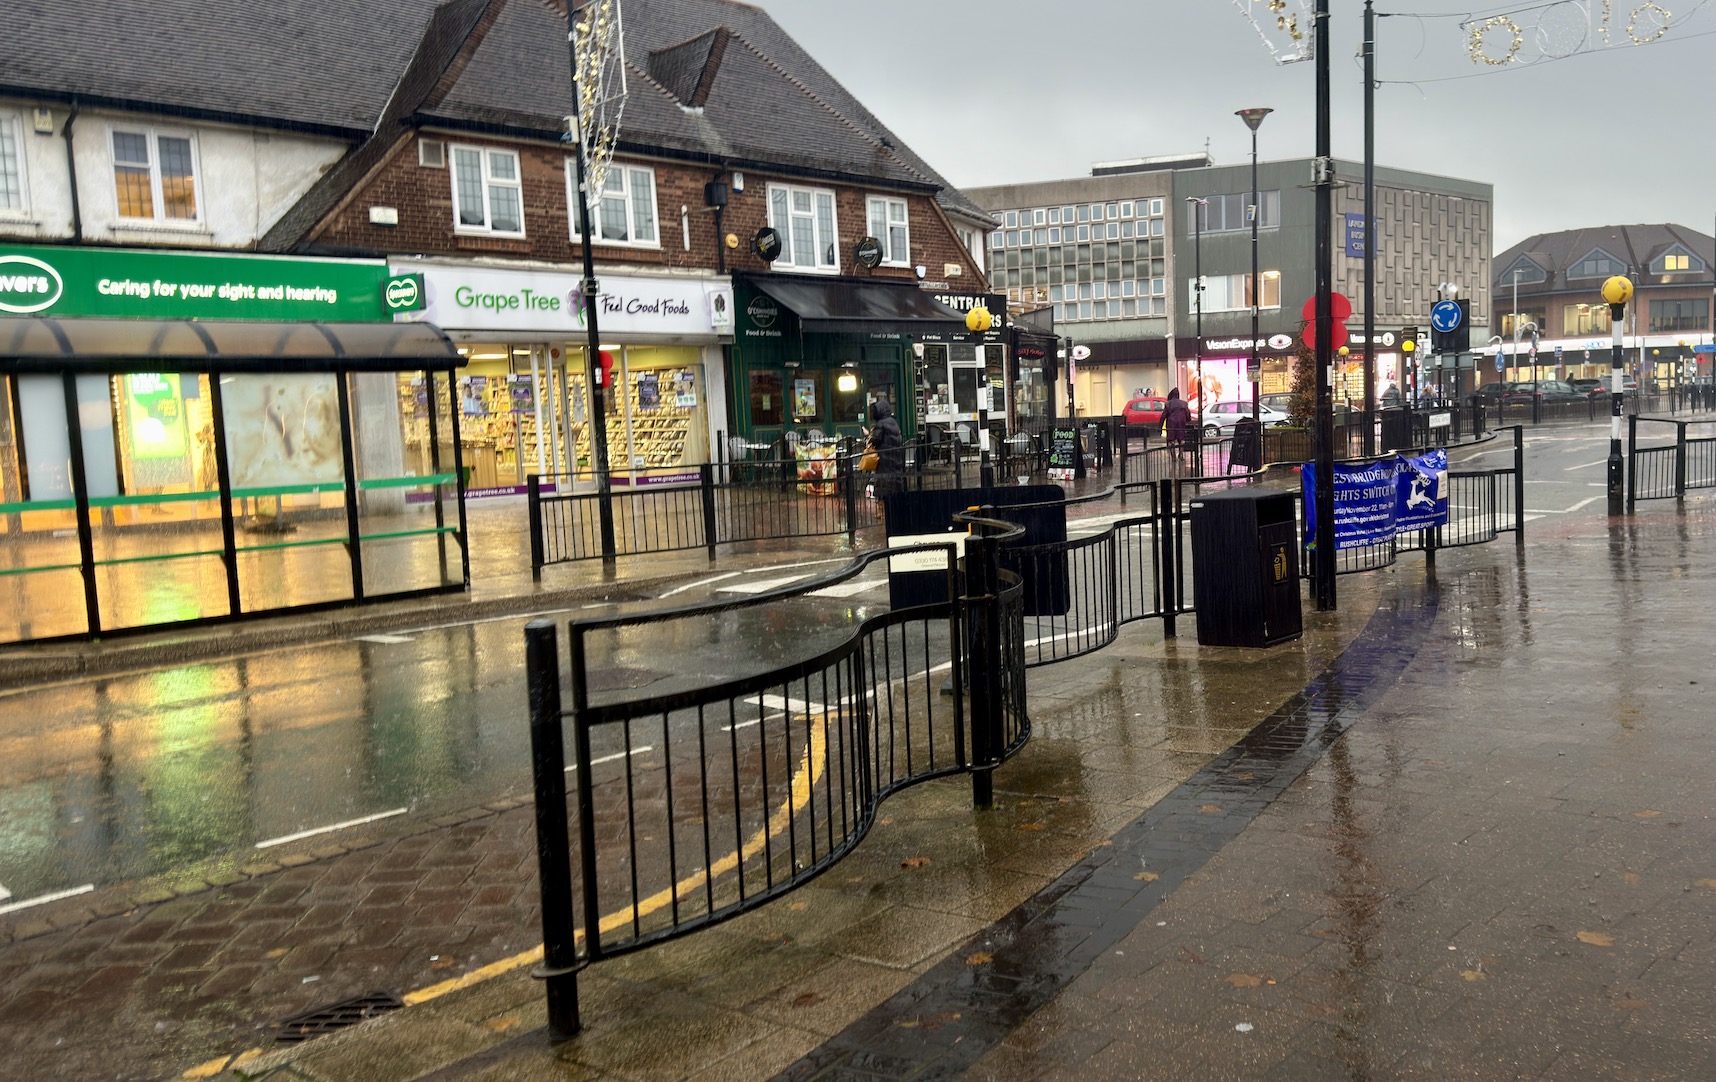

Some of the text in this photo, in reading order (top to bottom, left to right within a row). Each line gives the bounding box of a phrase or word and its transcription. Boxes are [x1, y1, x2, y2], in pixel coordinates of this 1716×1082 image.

[98, 278, 337, 304] Caring for your sight and hearing
[455, 285, 560, 314] Grape Tree
[601, 295, 690, 316] Feel Good Foods
[745, 329, 759, 337] Food
[1205, 338, 1266, 350] VisionExprss
[1054, 431, 1074, 439] FOOD
[1333, 472, 1351, 484] EST
[1351, 469, 1392, 483] BRIDG
[1334, 489, 1360, 501] GHTS
[1363, 485, 1389, 500] SWITCH
[1334, 507, 1346, 515] urday
[1346, 505, 1370, 514] November
